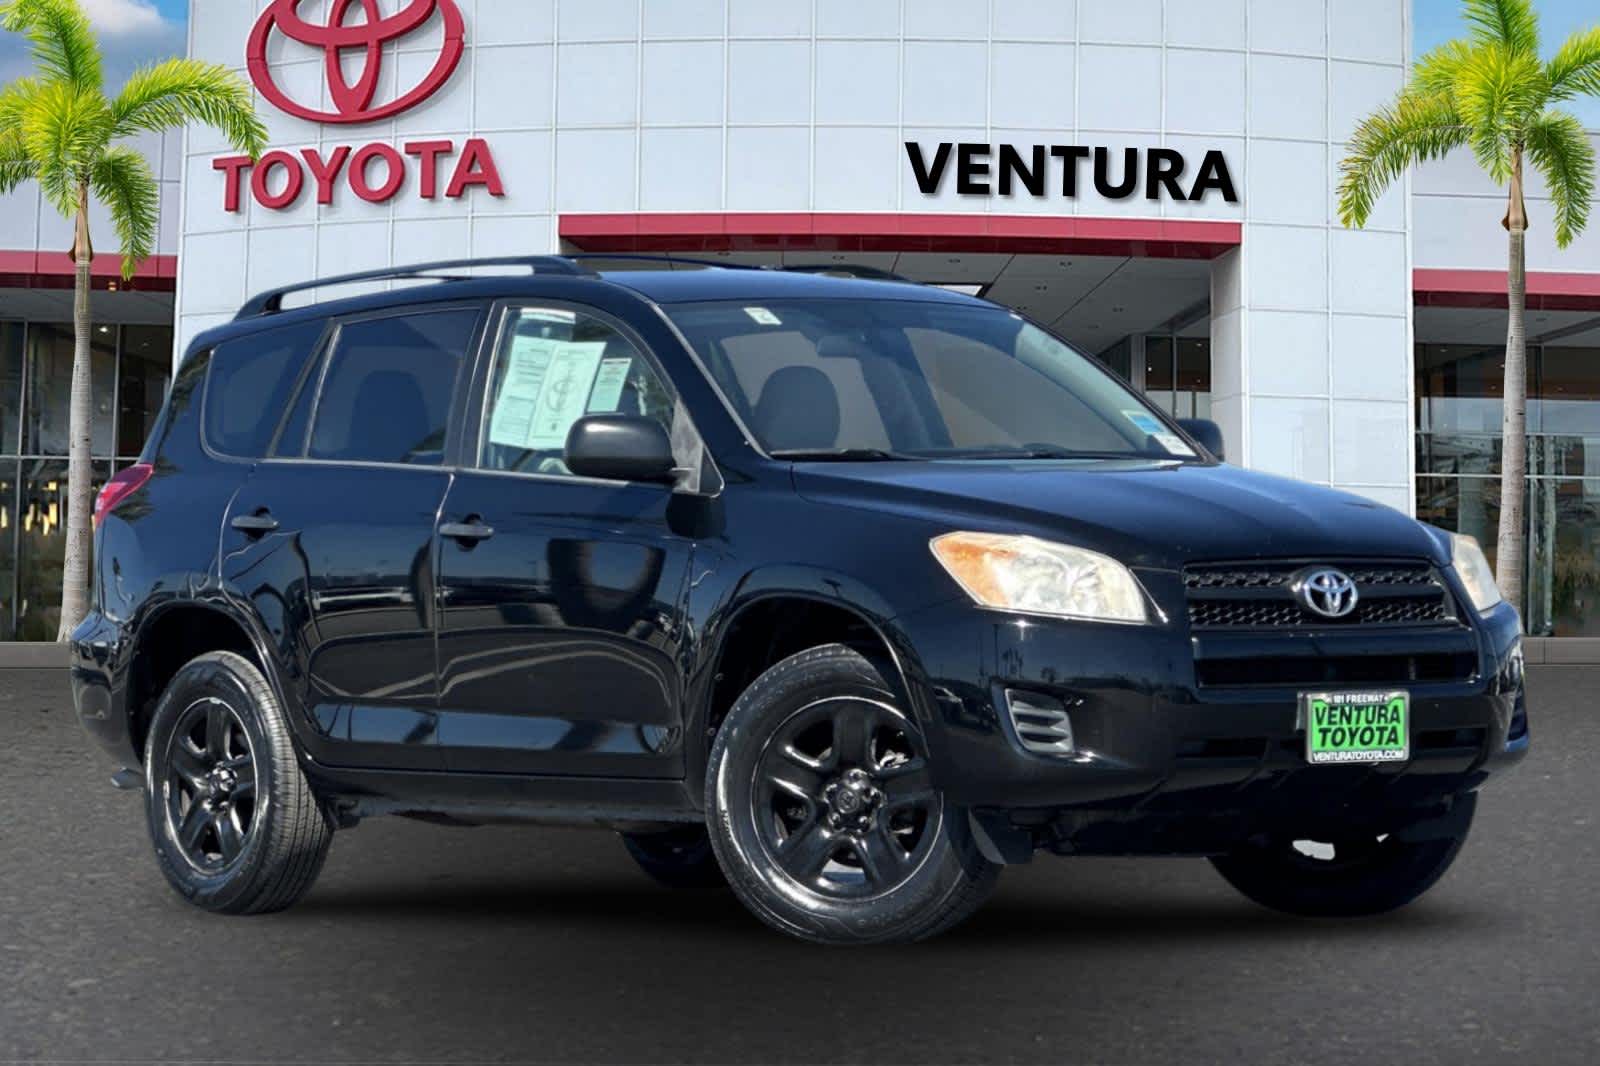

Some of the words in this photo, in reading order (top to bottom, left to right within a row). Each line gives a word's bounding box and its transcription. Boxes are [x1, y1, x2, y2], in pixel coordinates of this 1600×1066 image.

[212, 139, 505, 212] TOYOTA
[904, 142, 1239, 203] VENTURA
[1346, 694, 1384, 704] FREEWAY
[1315, 705, 1401, 726] VENTURA
[1318, 726, 1399, 747] TOYOTA
[1313, 750, 1404, 761] VENTURATOYOTA.COM
